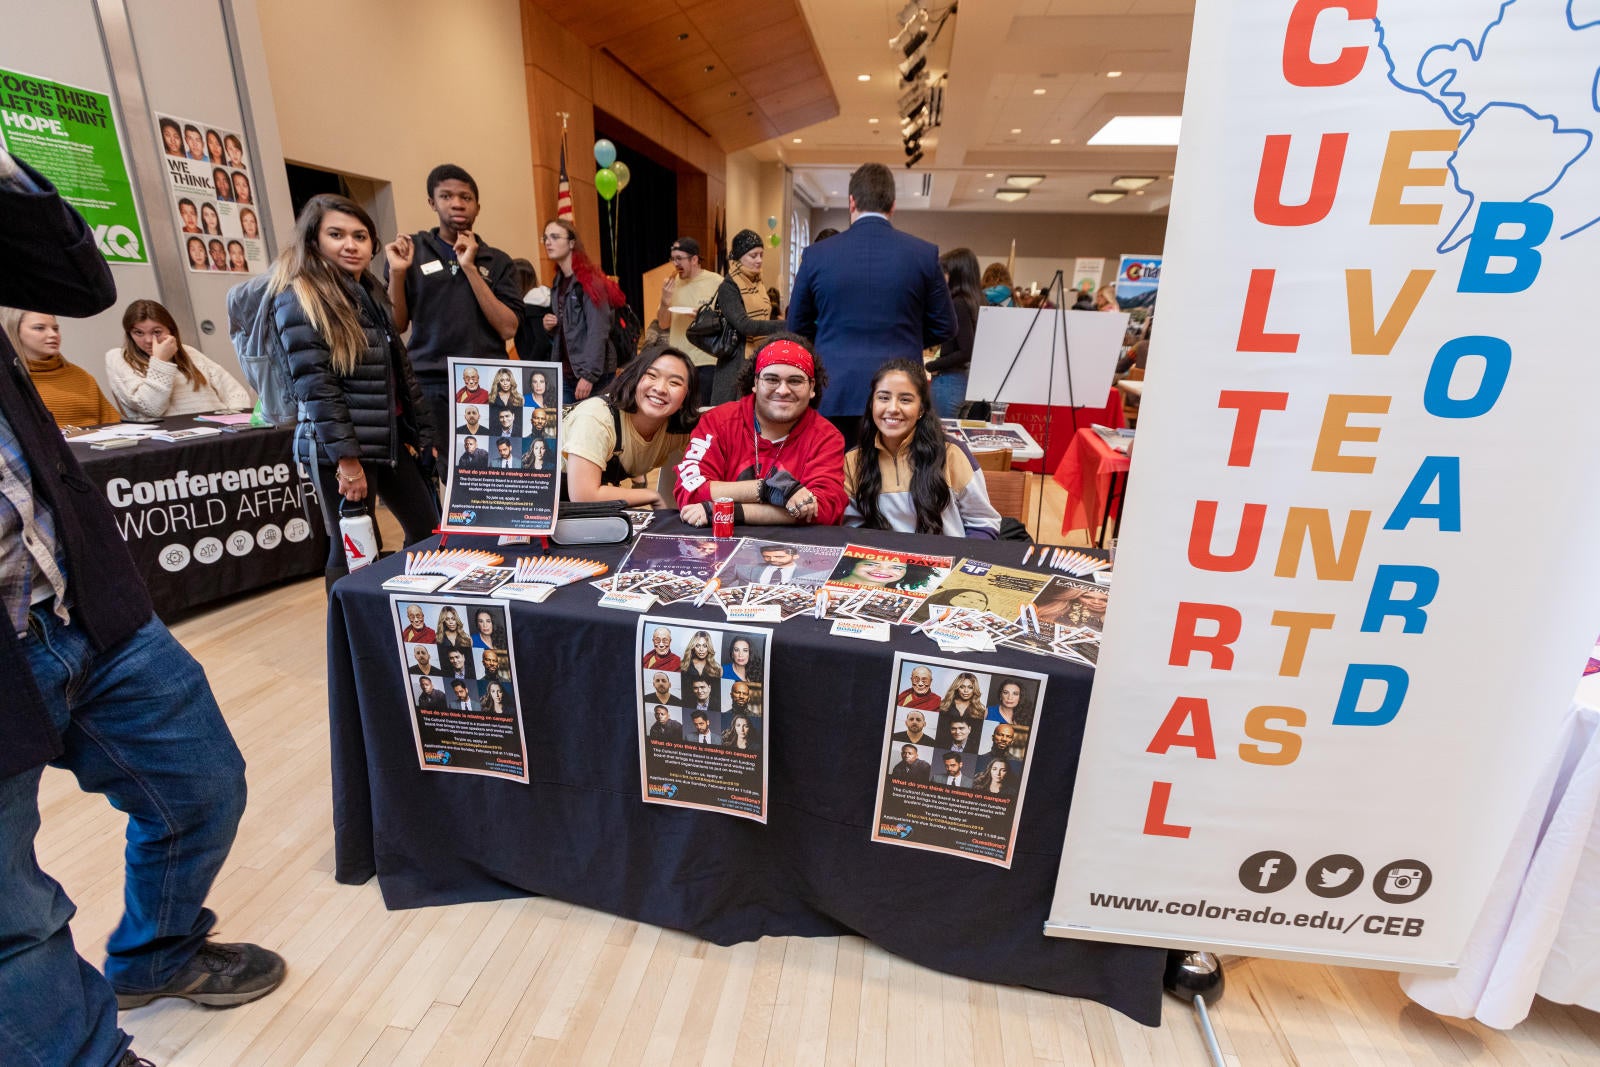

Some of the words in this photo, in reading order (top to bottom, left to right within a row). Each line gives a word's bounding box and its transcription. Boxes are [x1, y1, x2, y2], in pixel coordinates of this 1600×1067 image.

[0, 73, 104, 112] OGETHER,
[2, 109, 69, 137] HOPE.
[57, 104, 107, 128] PAINT
[167, 158, 191, 174] WE
[170, 171, 218, 190] THINK.
[1143, 0, 1378, 838] CULTURAL
[1238, 129, 1461, 766] EVENTS
[1332, 201, 1553, 726] BOARD
[106, 462, 290, 508] Conference
[114, 497, 227, 542] WORLD
[236, 481, 319, 523] AFFAIR
[843, 550, 900, 564] ANGELA
[906, 558, 951, 568] DAVIS
[1055, 579, 1109, 595] LAVERN
[950, 790, 973, 798] missing
[983, 796, 1011, 805] campus?
[1089, 891, 1425, 938] www.colorado.edu/CEB
